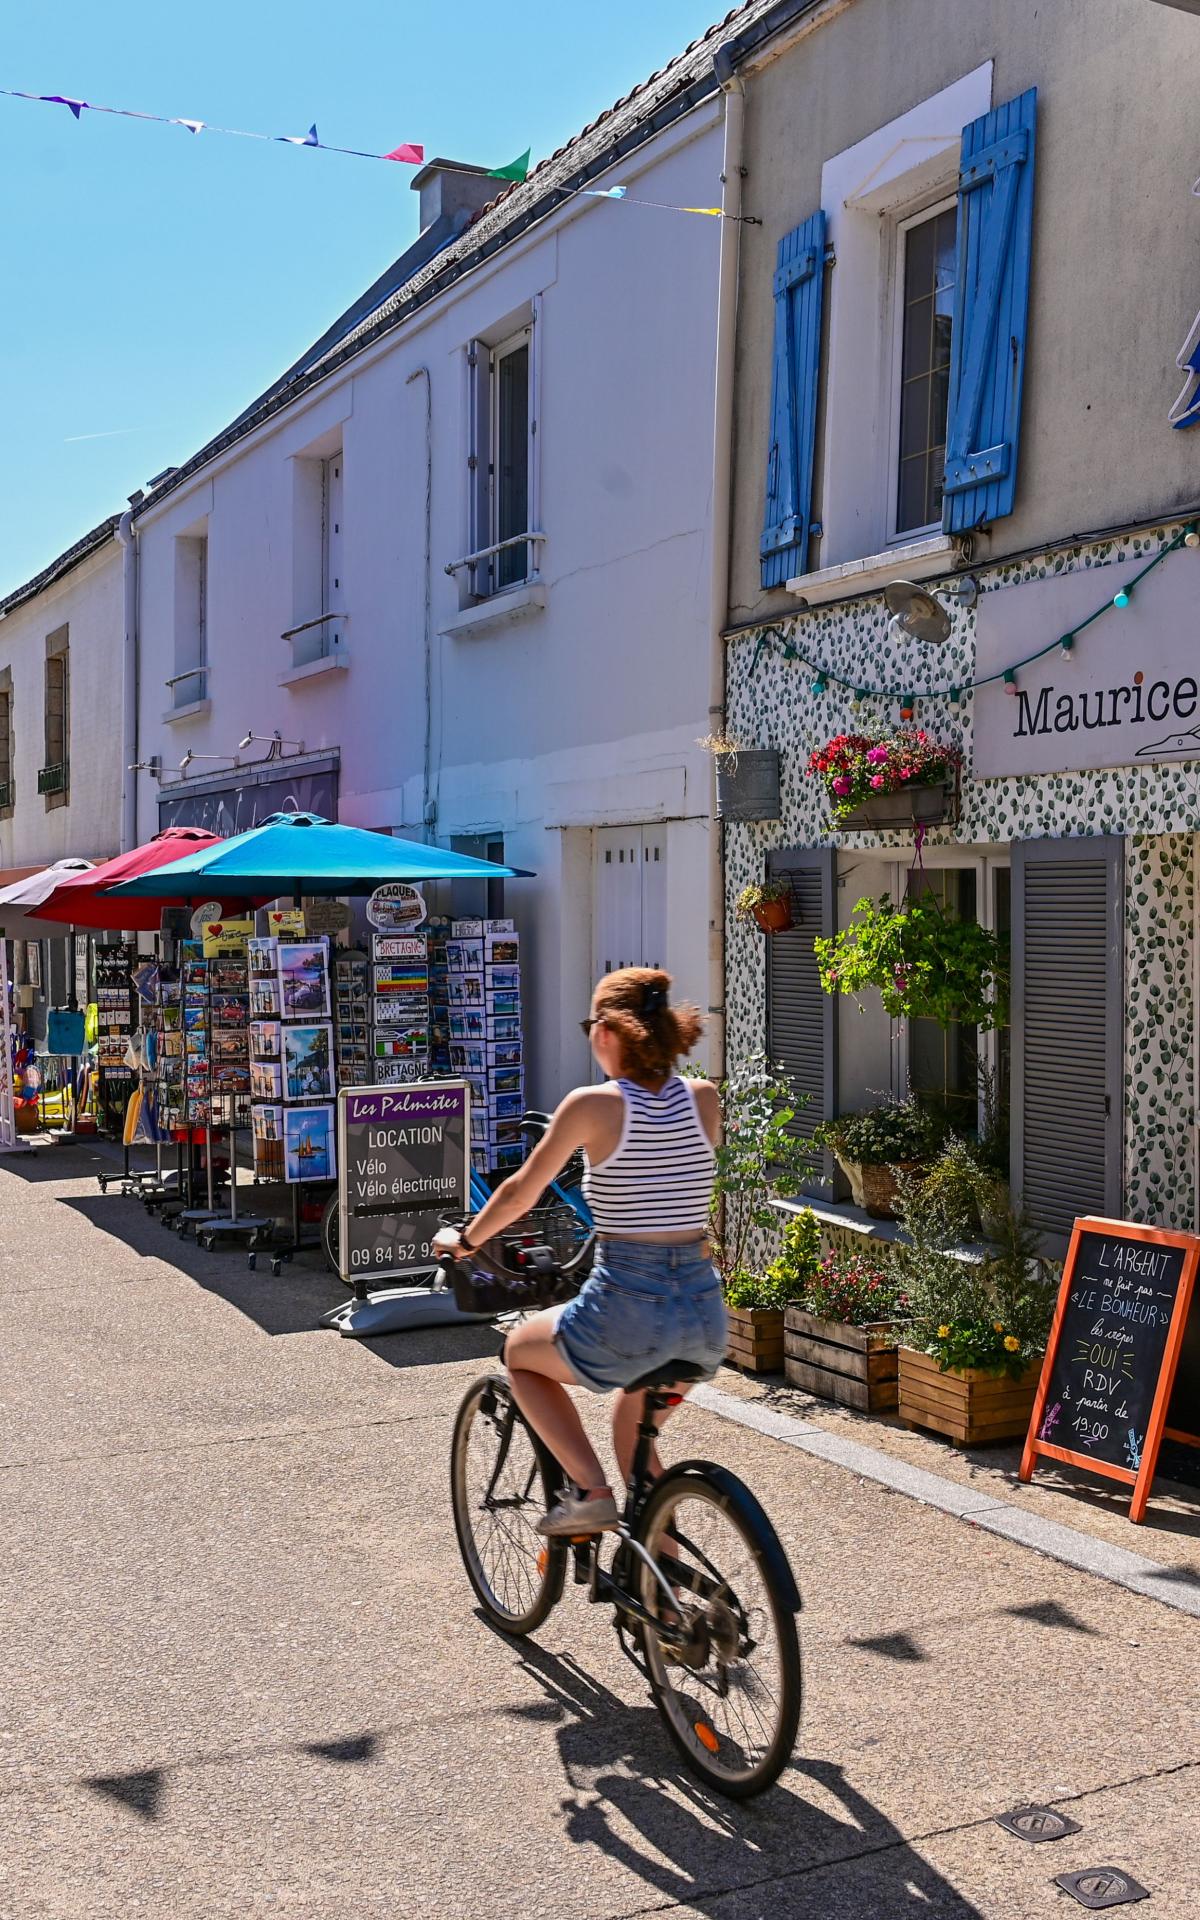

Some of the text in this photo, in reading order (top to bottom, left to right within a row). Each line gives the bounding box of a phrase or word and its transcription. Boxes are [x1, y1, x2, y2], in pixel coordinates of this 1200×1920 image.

[1013, 671, 1198, 737] Maurice
[380, 941, 422, 955] BRETAGNE
[377, 1061, 427, 1079] BRETAGNE
[353, 1093, 459, 1118] Les Palmistes
[368, 1126, 443, 1149] LOCATION
[356, 1158, 387, 1176] Vélo
[356, 1175, 457, 1198] Vélo électrique
[351, 1249, 370, 1266] 09
[375, 1246, 393, 1264] 84
[398, 1244, 416, 1261] 52
[1098, 1243, 1172, 1280] L'ARGENT
[1103, 1276, 1153, 1300] ne fait pas
[1090, 1318, 1134, 1349] les crêpes
[1089, 1343, 1118, 1371] OUI
[1083, 1369, 1121, 1396] RDV
[1062, 1385, 1129, 1419] à partir de
[1072, 1416, 1109, 1440] 19:00
